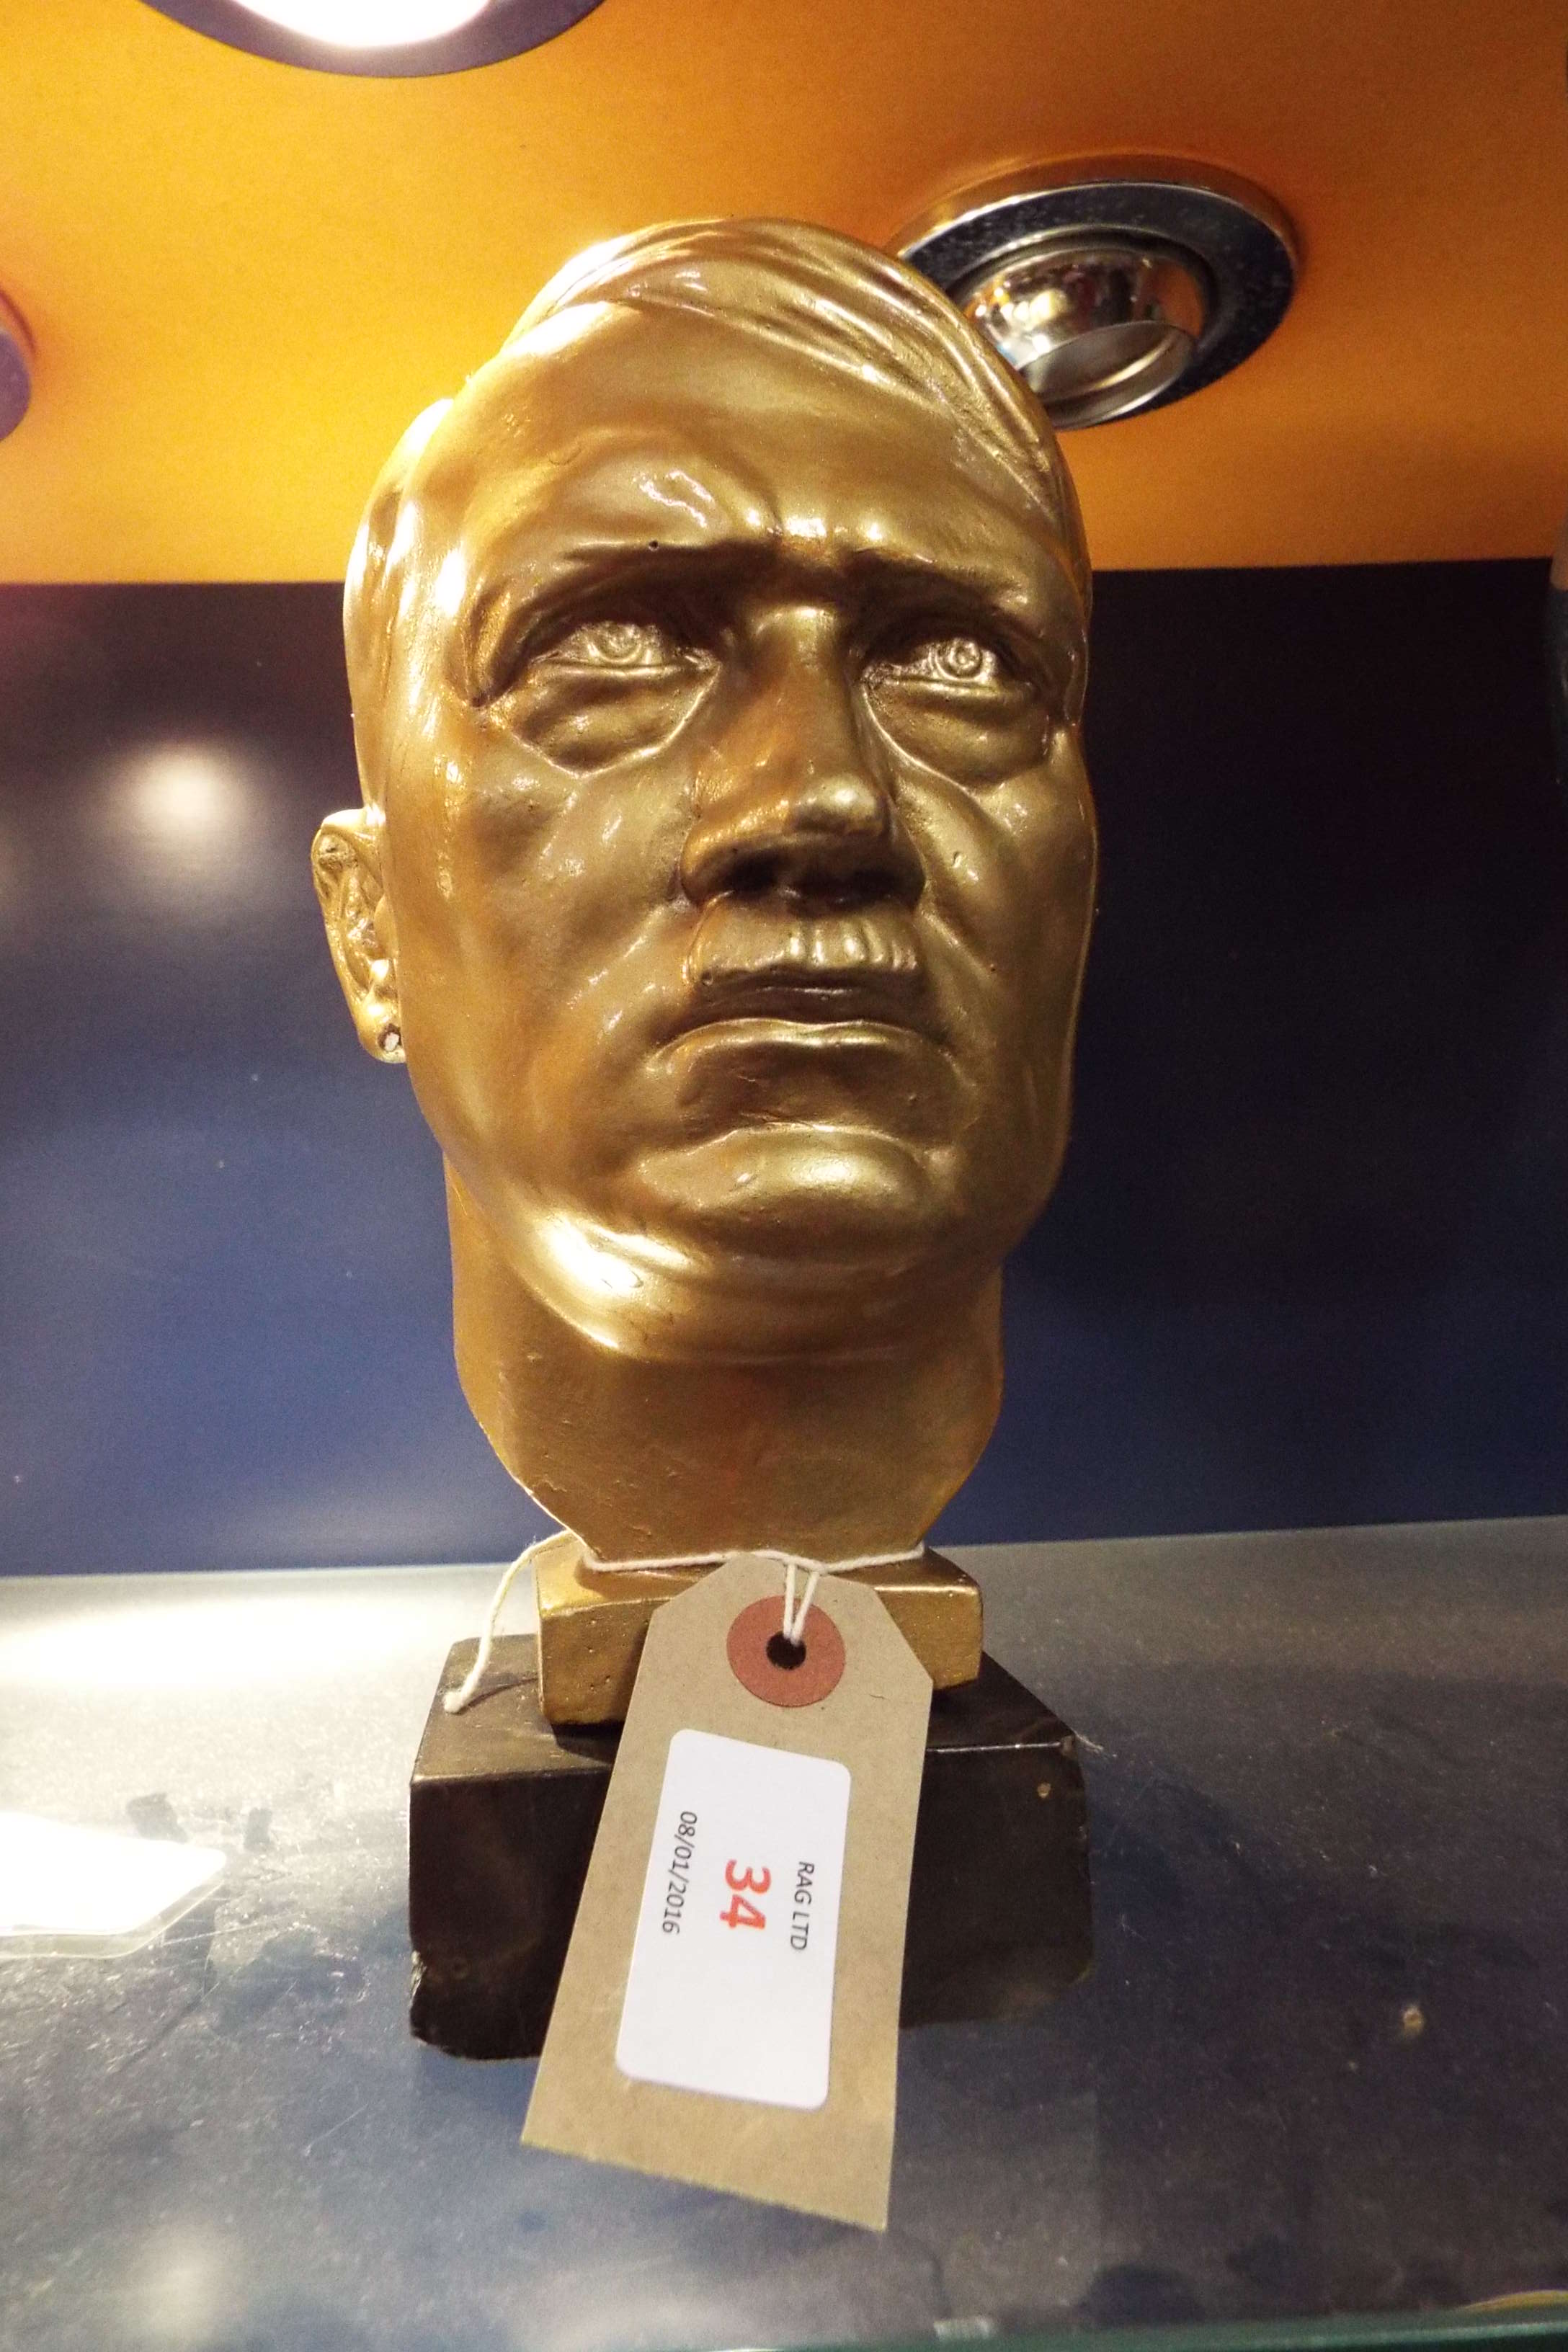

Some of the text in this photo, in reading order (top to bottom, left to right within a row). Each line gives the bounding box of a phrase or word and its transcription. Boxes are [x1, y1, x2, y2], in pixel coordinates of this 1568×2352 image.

[662, 1811, 698, 1935] 08/01/2016
[721, 1860, 772, 1930] 34
[790, 1861, 815, 1951] RAG LTD
